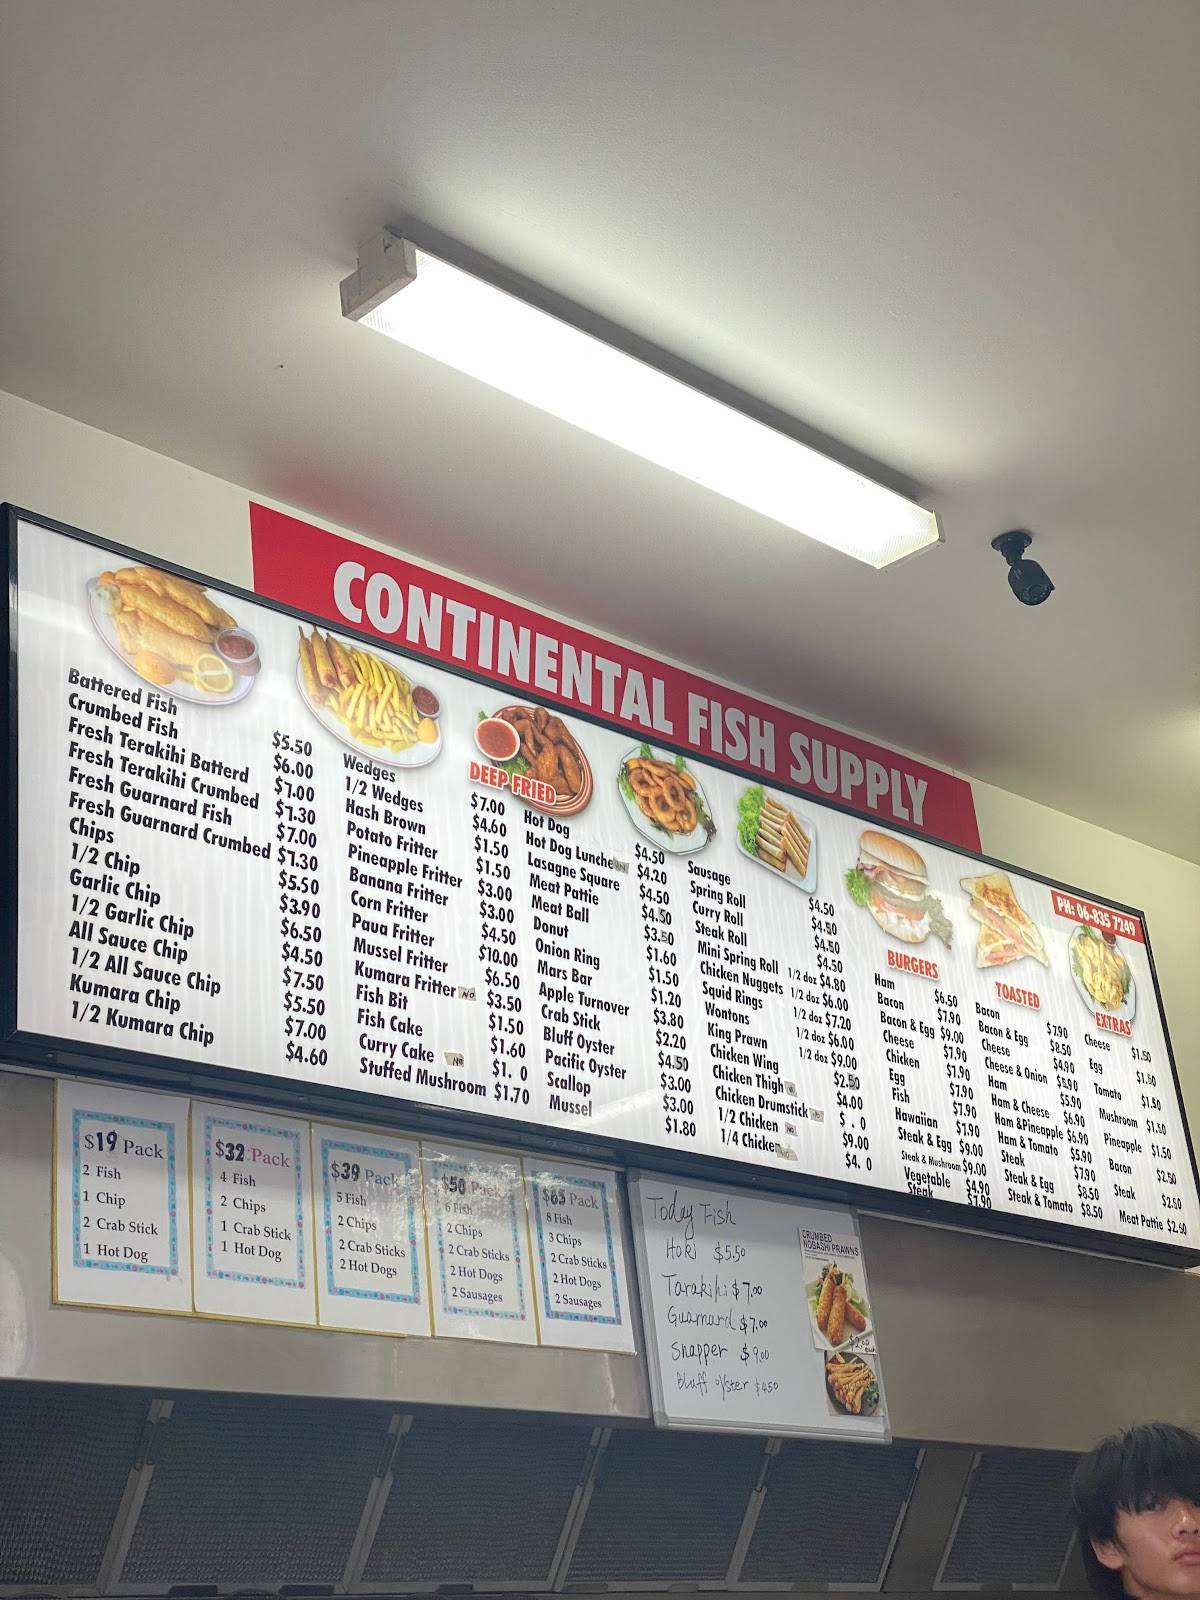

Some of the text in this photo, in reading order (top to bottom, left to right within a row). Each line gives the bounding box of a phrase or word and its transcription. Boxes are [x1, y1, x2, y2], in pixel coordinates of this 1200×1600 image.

[333, 561, 928, 826] CONTINENTAL FISH SUPPLY
[67, 667, 312, 757] Battered Fish $5.50
[68, 692, 313, 780] Crumbed Fish $6.00
[343, 752, 505, 816] Wedges $7.00
[470, 761, 556, 804] DEEP FRIED
[68, 765, 317, 849] Fresh Guarnard Fish $7.00
[345, 797, 509, 859] Hash Brown $1.50
[523, 809, 665, 865] Hot Dog $4.50
[687, 859, 834, 917] Sausage $4.50
[69, 867, 321, 943] Garlic Chip $6.50
[350, 889, 516, 946] Corn Fritter $4.50
[1056, 896, 1135, 936] PH: 06-835 7249
[351, 912, 518, 968] Paua Fritter $10.00
[535, 937, 679, 988] Onion Ring $1.50
[697, 939, 846, 993] Mini Spring Roll 1/2 doz $4.80
[887, 949, 938, 979] BURGERS
[537, 958, 681, 1008] Mars Bar $1.20
[874, 972, 958, 1008] Ham $6.50
[995, 981, 1039, 1008] TOASTED
[538, 981, 684, 1029] Apple Turnover $3.80
[877, 990, 961, 1026] Bacon $7.90
[72, 1000, 328, 1066] 1/2 Kumara Chip $4.60
[879, 1009, 964, 1045] Bacon & Egg $9.00
[1096, 1012, 1131, 1035] EXTRAS
[707, 1021, 857, 1071] King Prawn 1/2 doz $9.00
[981, 1037, 1075, 1075] Cheese $4.90
[1084, 1032, 1151, 1063] Cheese $1.50
[359, 1056, 530, 1105] Stuffed Mushroom $1.70
[987, 1074, 1082, 1110] Ham $5.90
[549, 1093, 696, 1137] Mussel $1.80
[84, 1130, 164, 1158] $19 Pack
[216, 1139, 290, 1168] $32 Pack
[1103, 1131, 1172, 1160] Pineapple $1.50
[83, 1165, 121, 1179] 2 Fish
[221, 1172, 256, 1187] 4 Fish
[364, 1169, 399, 1185] Pack
[1000, 1149, 1096, 1183] Steak $7.90
[83, 1191, 126, 1208] 1 Chip
[221, 1196, 266, 1215] 2 Chips
[337, 1192, 366, 1206] 5 Fish
[84, 1217, 158, 1235] 2 Crab Stick
[338, 1215, 376, 1232] 2 Chips
[547, 1213, 572, 1225] 8 Fish
[646, 1190, 736, 1240] Today Fish
[221, 1221, 291, 1240] 1 Crab Stick
[549, 1233, 582, 1248] 3 Chips
[802, 1230, 832, 1243] CRUMBED
[84, 1243, 148, 1263] 1 Hot Dog
[222, 1241, 282, 1262] 1 Hot Dog
[339, 1239, 406, 1258] 2 Crab Sticks
[552, 1253, 607, 1269] 2 Crab Sticks
[714, 1242, 745, 1263] $5.50
[832, 1244, 859, 1256] PRAWNS
[340, 1259, 397, 1278] 2 Hot Dogs
[554, 1274, 601, 1290] 2 Hot Dogs
[556, 1294, 602, 1310] 2 Sausages
[740, 1315, 767, 1334] $7.00
[672, 1342, 728, 1366] Snapper
